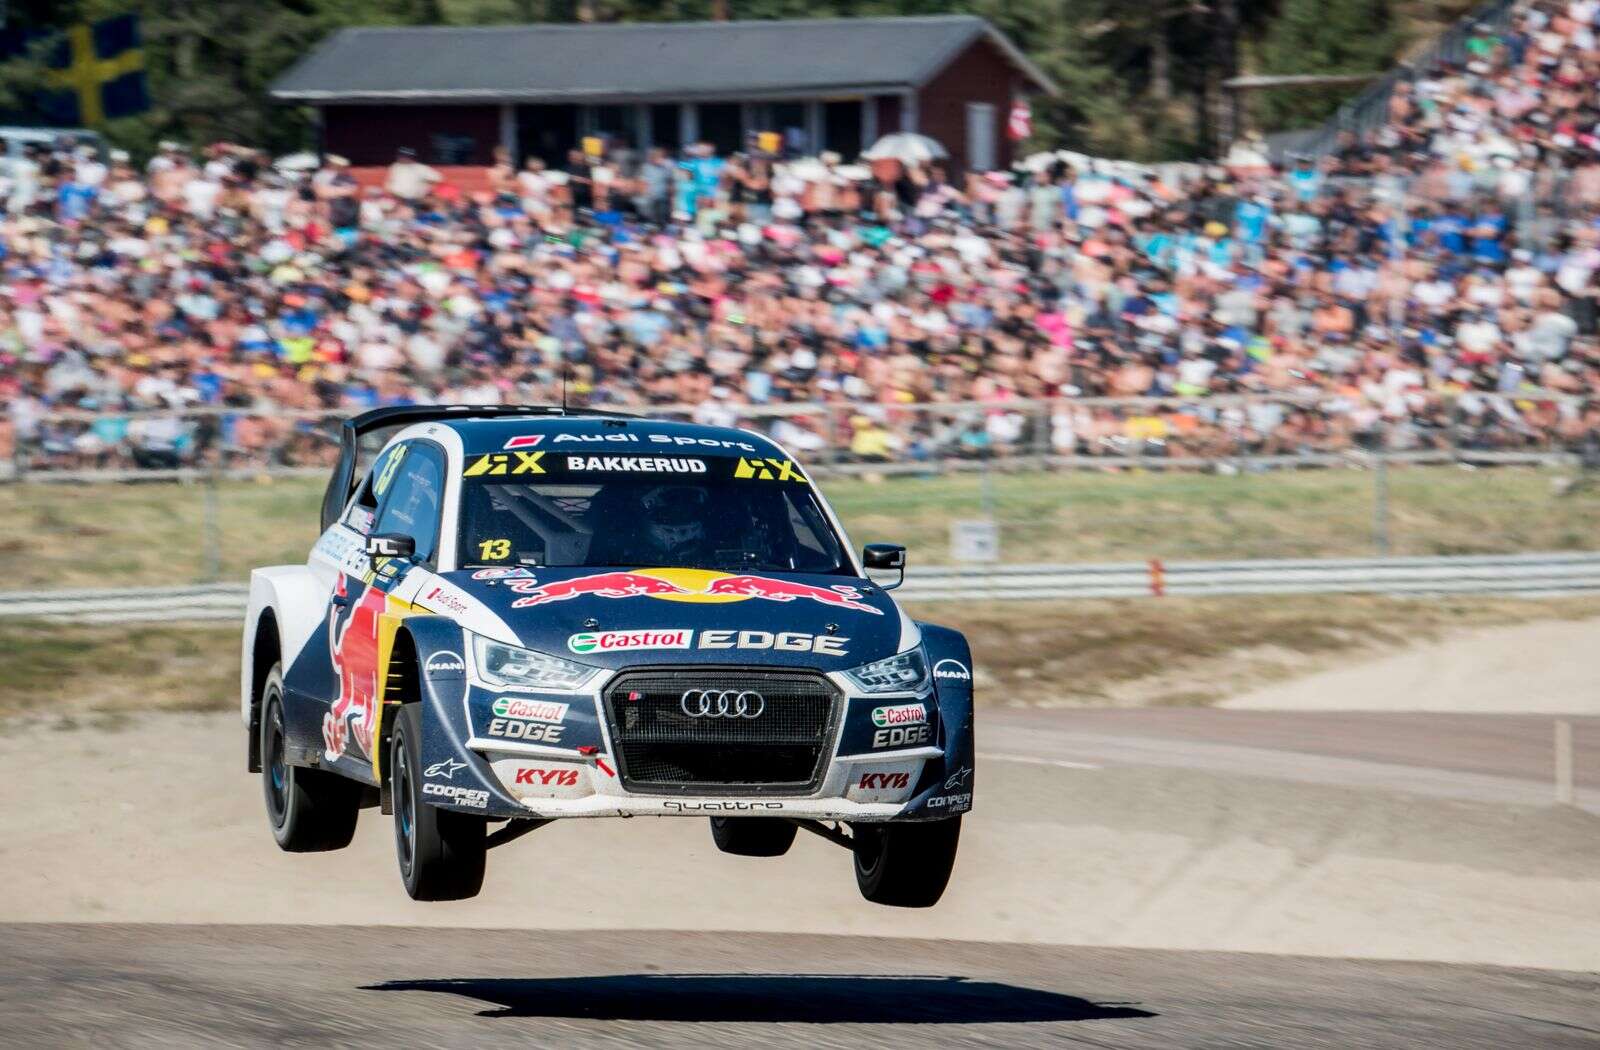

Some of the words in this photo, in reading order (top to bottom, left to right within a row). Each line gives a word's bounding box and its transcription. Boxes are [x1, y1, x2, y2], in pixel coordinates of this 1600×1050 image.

[553, 433, 639, 443] Audi
[648, 435, 755, 452] Sport
[567, 456, 707, 473] BAKKERUD
[478, 539, 512, 560] 13
[600, 631, 684, 648] Castrol
[698, 630, 850, 656] EDGE
[428, 662, 463, 671] MAN
[935, 670, 970, 679] MAN
[508, 702, 563, 721] Castrol
[887, 706, 925, 724] Castrol
[488, 719, 567, 743] EDGE
[872, 724, 931, 748] EDGE
[515, 768, 579, 786] KYB
[858, 773, 910, 789] KYB
[422, 783, 490, 800] COOPER
[454, 797, 488, 809] TIRES
[663, 800, 784, 813] quattro
